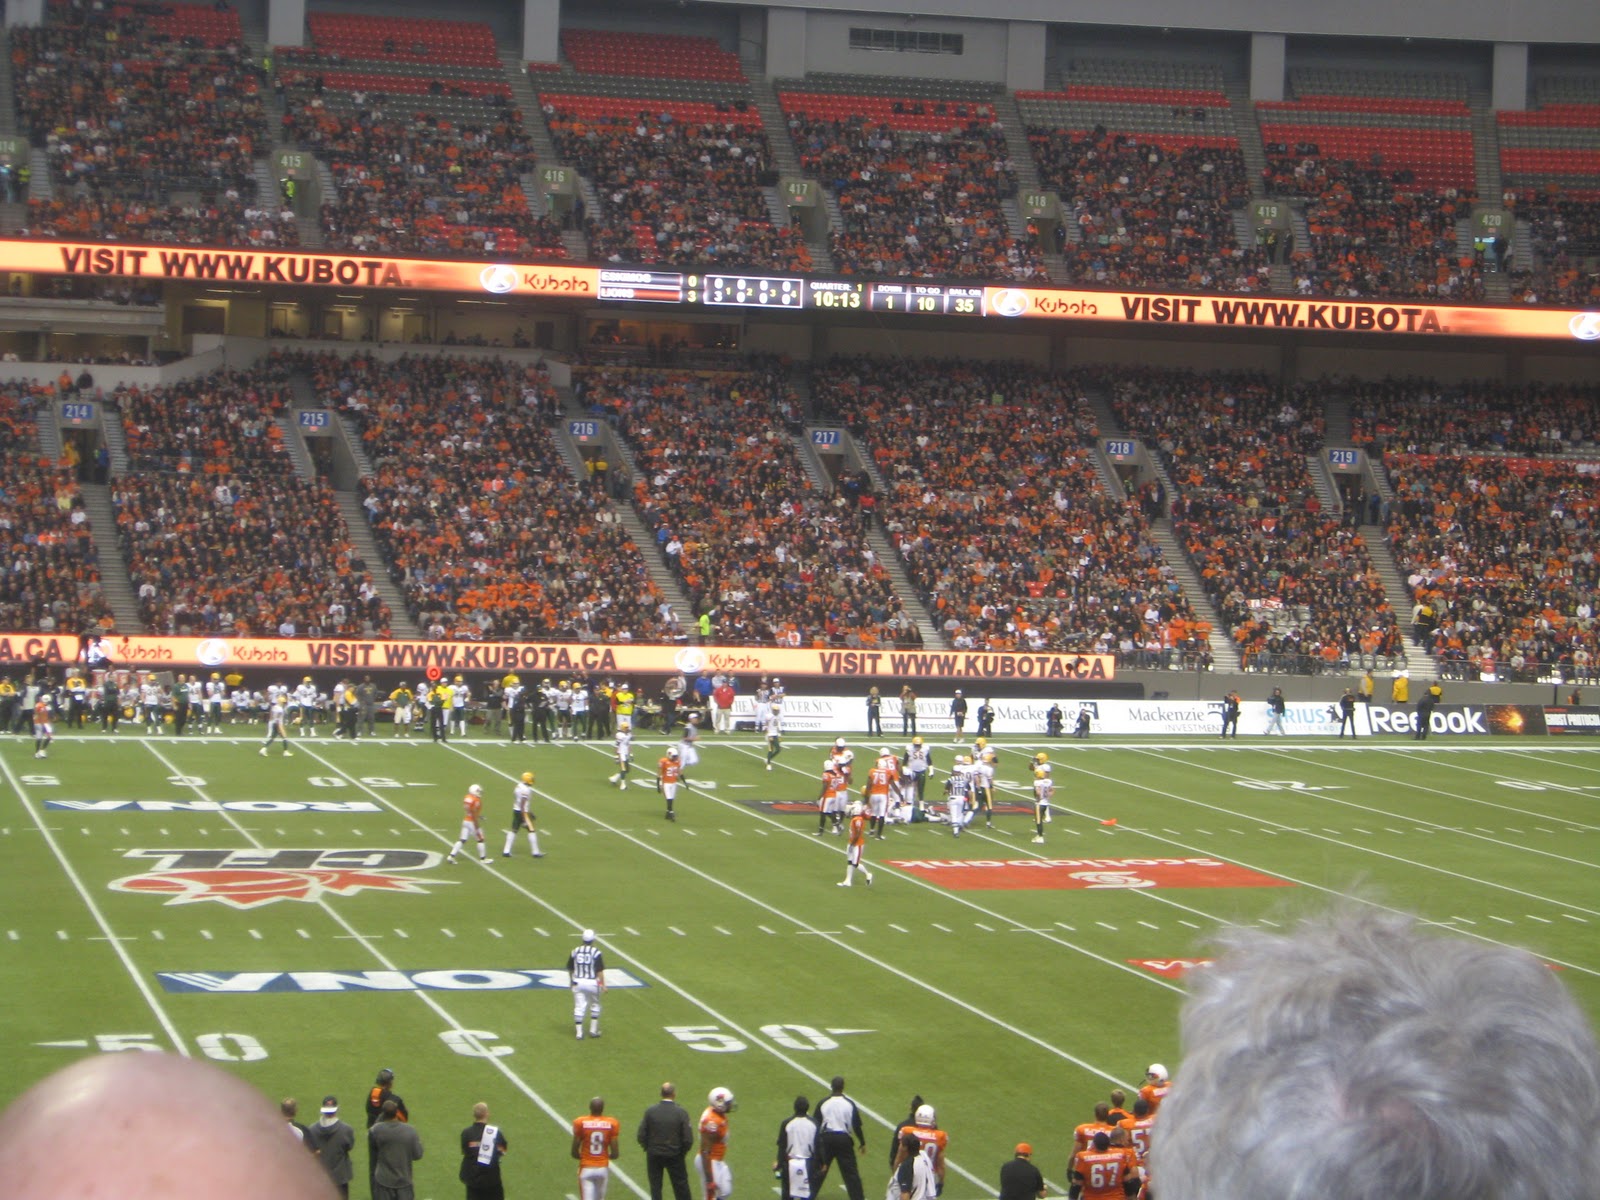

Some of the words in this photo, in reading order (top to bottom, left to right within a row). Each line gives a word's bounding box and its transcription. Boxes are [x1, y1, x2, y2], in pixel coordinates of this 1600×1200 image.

[281, 154, 302, 168] 415
[544, 169, 565, 183] 416
[789, 182, 808, 195] 417
[1027, 194, 1047, 208] 418
[1257, 205, 1278, 218] 419
[1482, 214, 1502, 227] 420
[60, 247, 150, 274] VISIT
[523, 272, 590, 292] Kubota
[688, 275, 698, 287] 0
[714, 277, 723, 289] 0
[736, 279, 746, 290] 0
[759, 280, 769, 291] 0
[782, 281, 791, 292] 0
[856, 284, 863, 292] 1
[877, 284, 903, 293] DOWN
[601, 287, 634, 299] LIONS
[687, 290, 697, 302] 3
[714, 290, 723, 302] 3
[736, 291, 746, 303] 0
[758, 292, 768, 304] 0
[781, 293, 791, 305] 0
[725, 287, 731, 295] 1
[746, 288, 753, 296] 2
[769, 289, 777, 297] 3
[790, 290, 797, 298] 4
[915, 286, 927, 294] TO
[928, 286, 940, 295] GO
[949, 288, 968, 296] BALL
[813, 291, 861, 308] 10:13
[885, 296, 894, 309] 1
[917, 297, 935, 311] 10
[954, 299, 974, 313] 35
[1034, 297, 1098, 315] Kubota
[1120, 296, 1201, 322] VISIT
[65, 404, 88, 418] 214
[302, 412, 325, 426] 215
[572, 422, 594, 435] 216
[815, 431, 836, 444] 217
[1109, 442, 1130, 455] 218
[1332, 451, 1353, 464] 219
[116, 644, 173, 660] Kubota
[233, 645, 289, 661] Kubota
[307, 643, 374, 666] VISIT
[385, 644, 617, 670] WWW.KUBOTA.CA
[709, 653, 760, 669] Kubota
[819, 652, 882, 675] VISIT
[890, 653, 1106, 680] WWW.KUBOTA.CA
[998, 705, 1076, 720] Mackeie
[1129, 706, 1205, 722] Mackenzie
[1266, 708, 1326, 724] SRIUS
[1165, 724, 1231, 733] INVESTMEN
[872, 772, 887, 785] 79
[46, 800, 384, 811] RONA
[121, 848, 444, 871] CFL
[889, 858, 1225, 869] Scotiabank
[156, 970, 645, 991] RONA
[1090, 1162, 1119, 1188] 67
